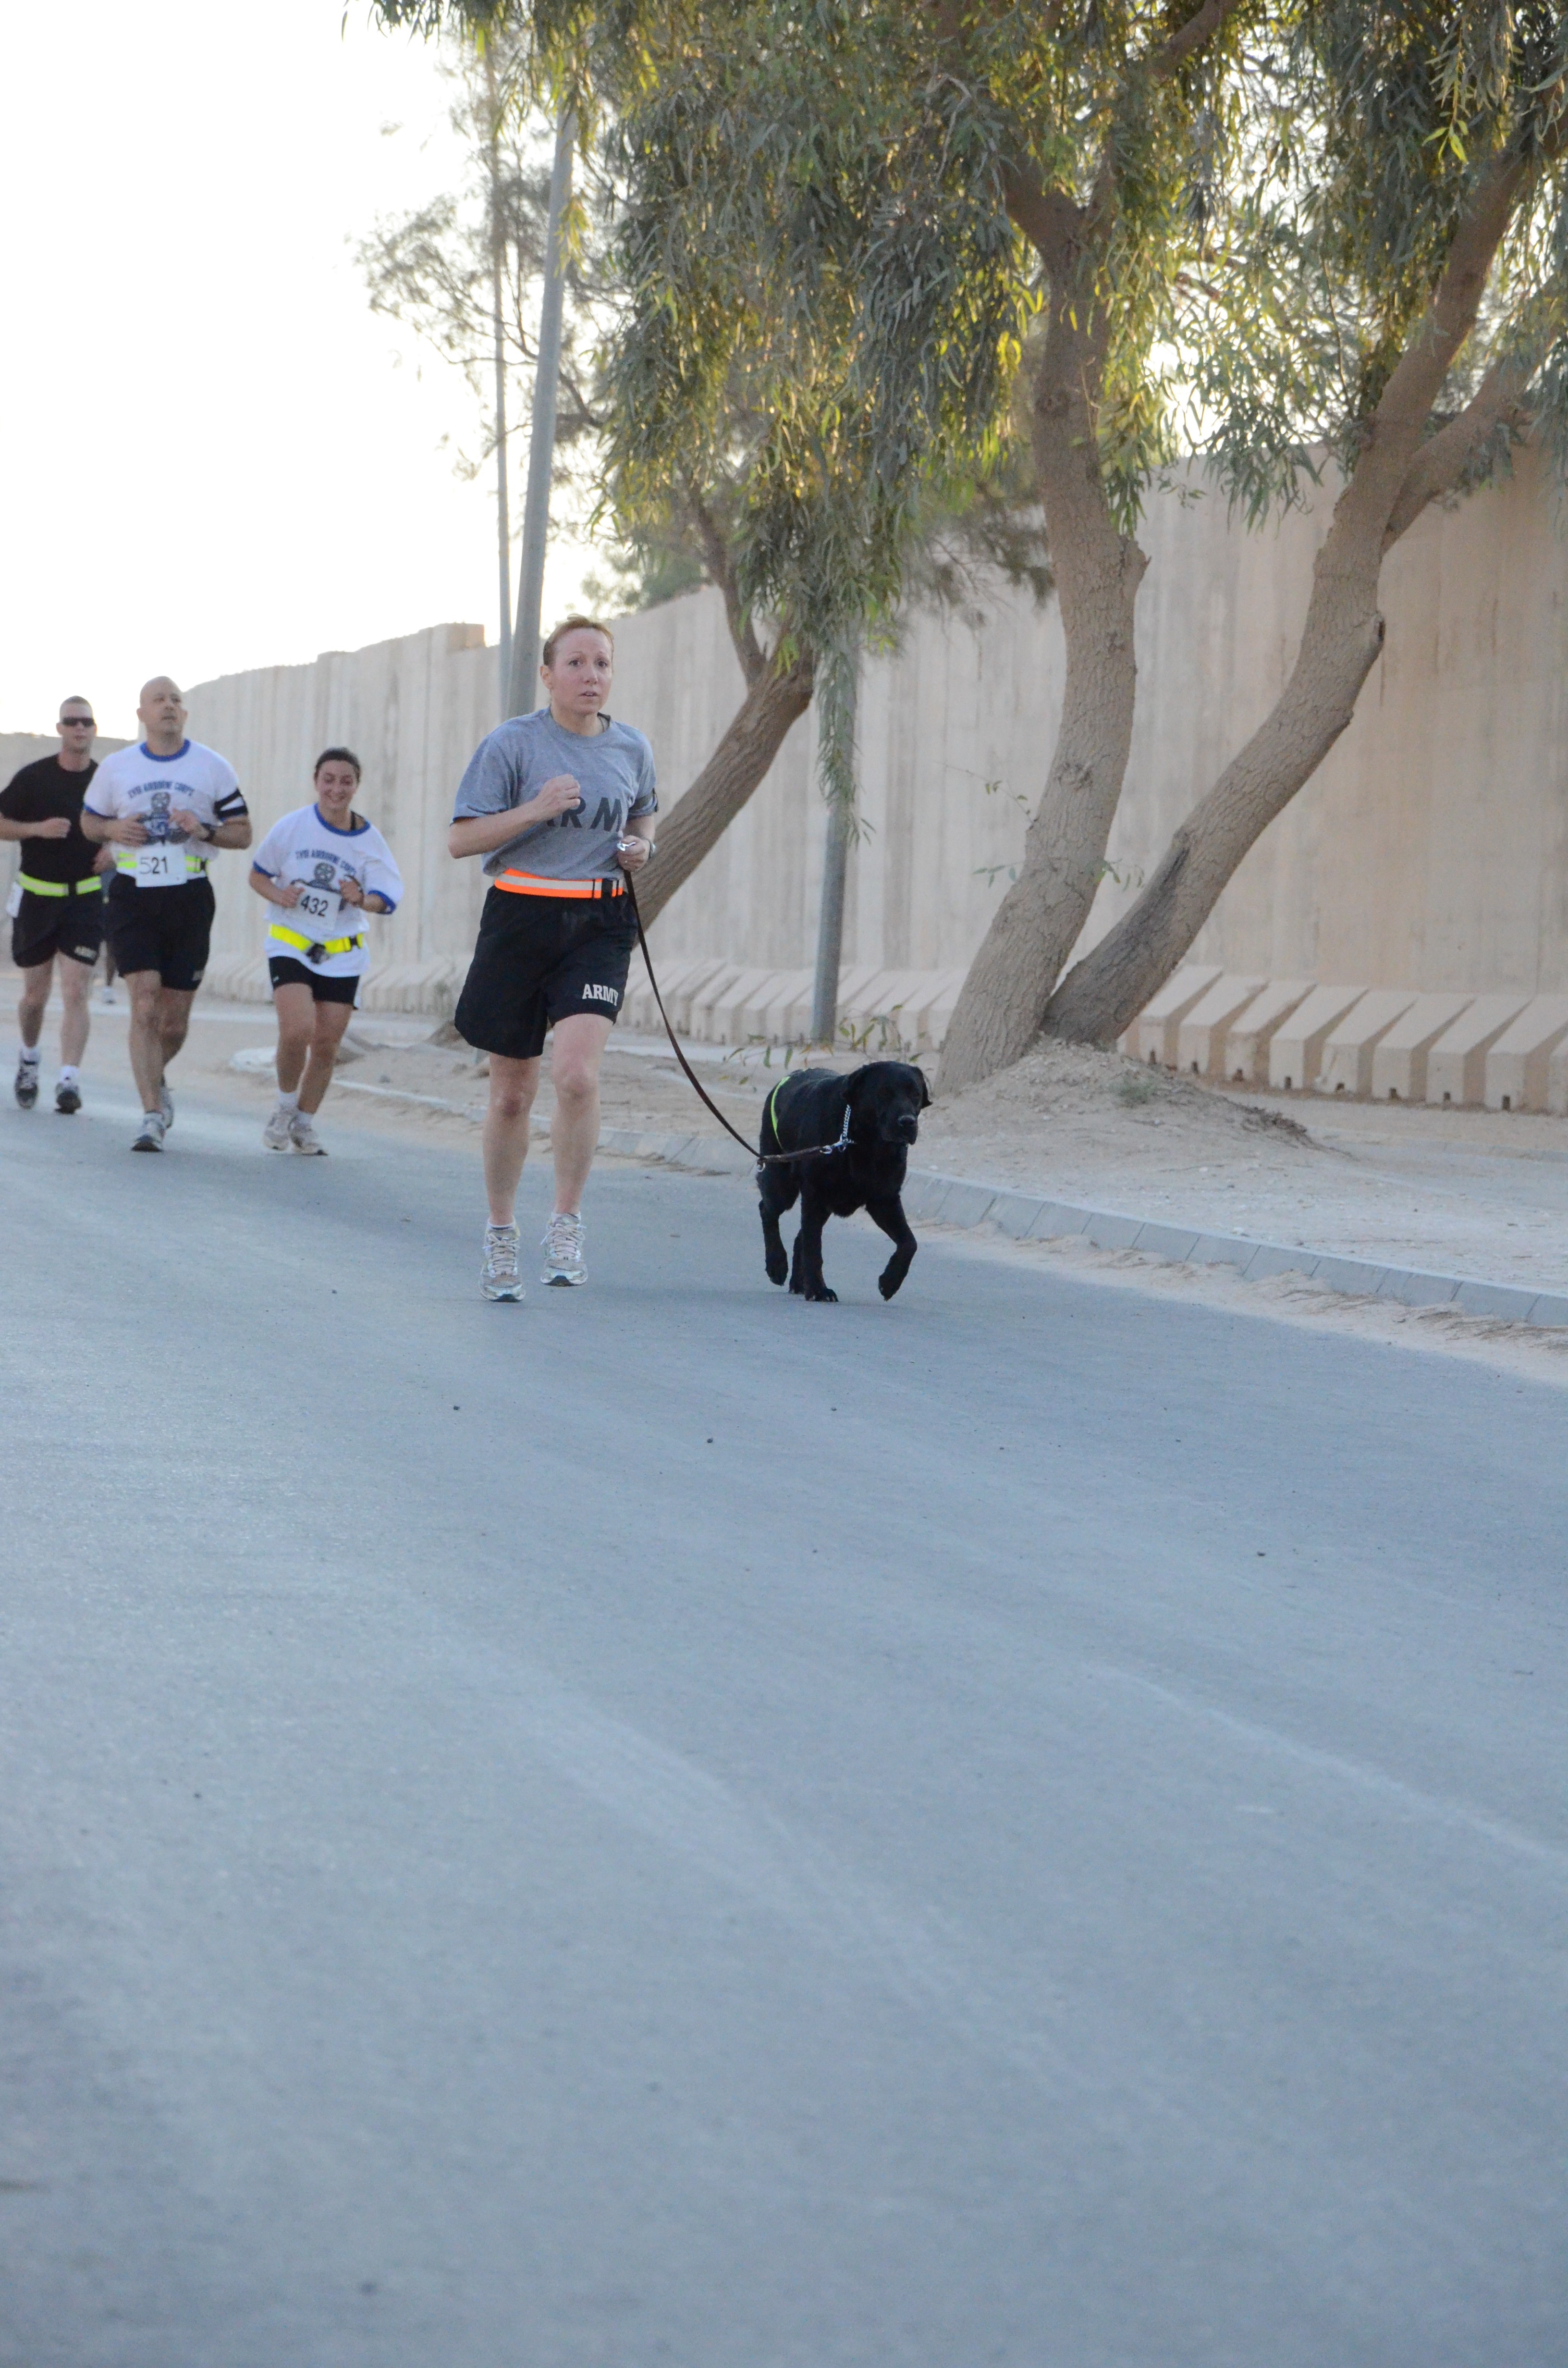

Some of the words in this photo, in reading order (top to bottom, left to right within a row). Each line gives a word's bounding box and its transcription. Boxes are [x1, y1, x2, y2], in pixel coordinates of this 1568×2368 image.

[139, 856, 168, 875] 521
[301, 895, 329, 917] 432
[582, 984, 619, 1007] ARMY
